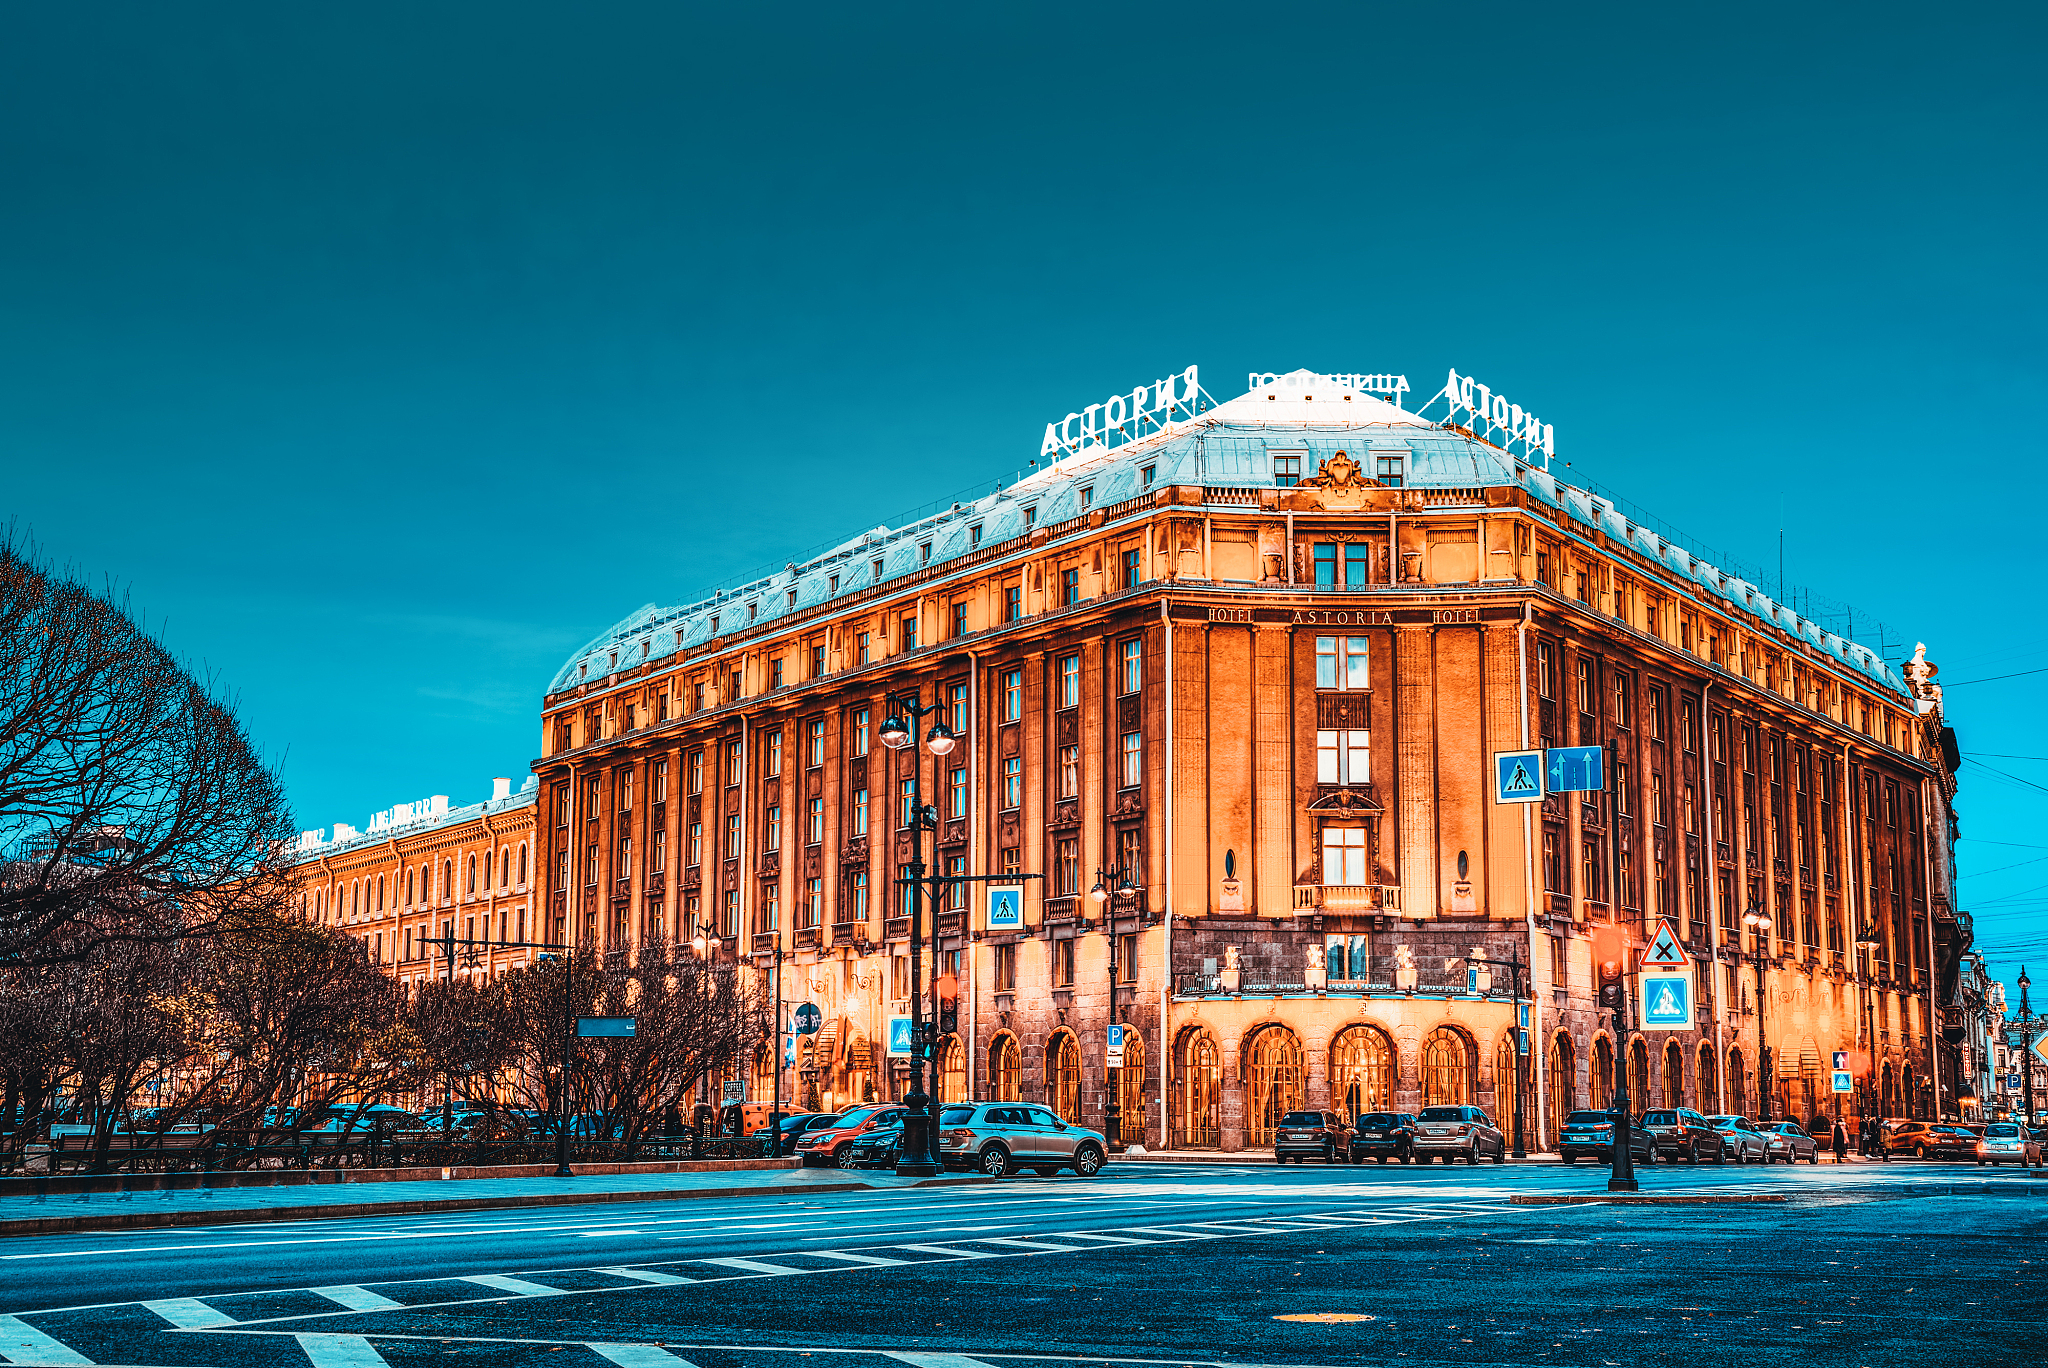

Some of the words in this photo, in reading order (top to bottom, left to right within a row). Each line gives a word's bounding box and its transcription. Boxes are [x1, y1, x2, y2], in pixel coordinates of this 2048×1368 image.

[1248, 372, 1411, 394] ГОНИЦА
[1040, 364, 1199, 457] АСТОРИЯ
[1208, 608, 1255, 623] HOTEL
[1292, 610, 1393, 625] ASTORIA
[1432, 609, 1482, 624] HOTEL
[724, 1082, 743, 1092] COFFEE
